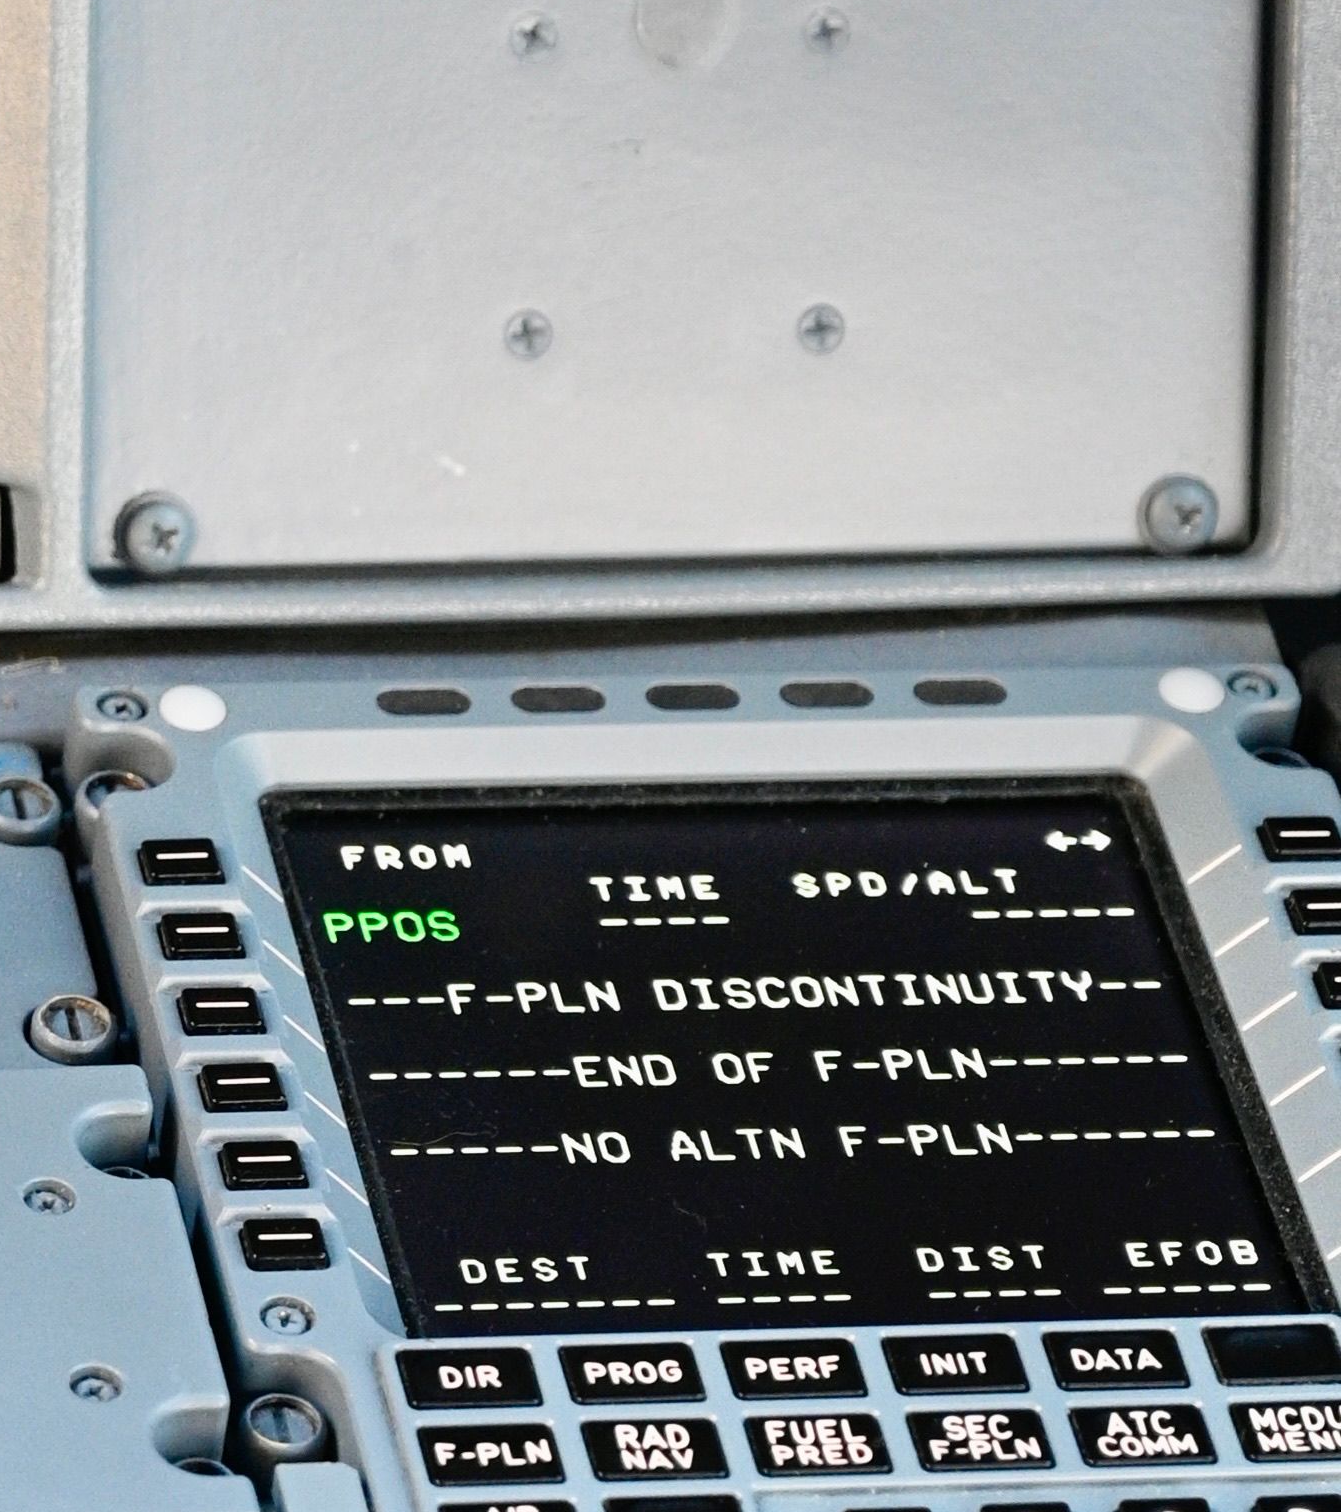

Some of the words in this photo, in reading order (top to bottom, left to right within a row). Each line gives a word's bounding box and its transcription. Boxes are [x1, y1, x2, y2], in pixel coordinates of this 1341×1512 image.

[339, 843, 472, 871] FROM
[588, 874, 720, 902] TIME
[791, 868, 1017, 899] SPD/ALT
[322, 910, 461, 944] PPOS
[670, 1127, 806, 1162] ALTN
[458, 1255, 589, 1284] DEST
[915, 1244, 1044, 1273] DIST
[1124, 1239, 1259, 1268] EFOB
[583, 1359, 683, 1385] PROG
[744, 1354, 840, 1381] PERF
[919, 1351, 987, 1376] INIT
[1070, 1347, 1163, 1371] DATA
[438, 1364, 503, 1389] DIR
